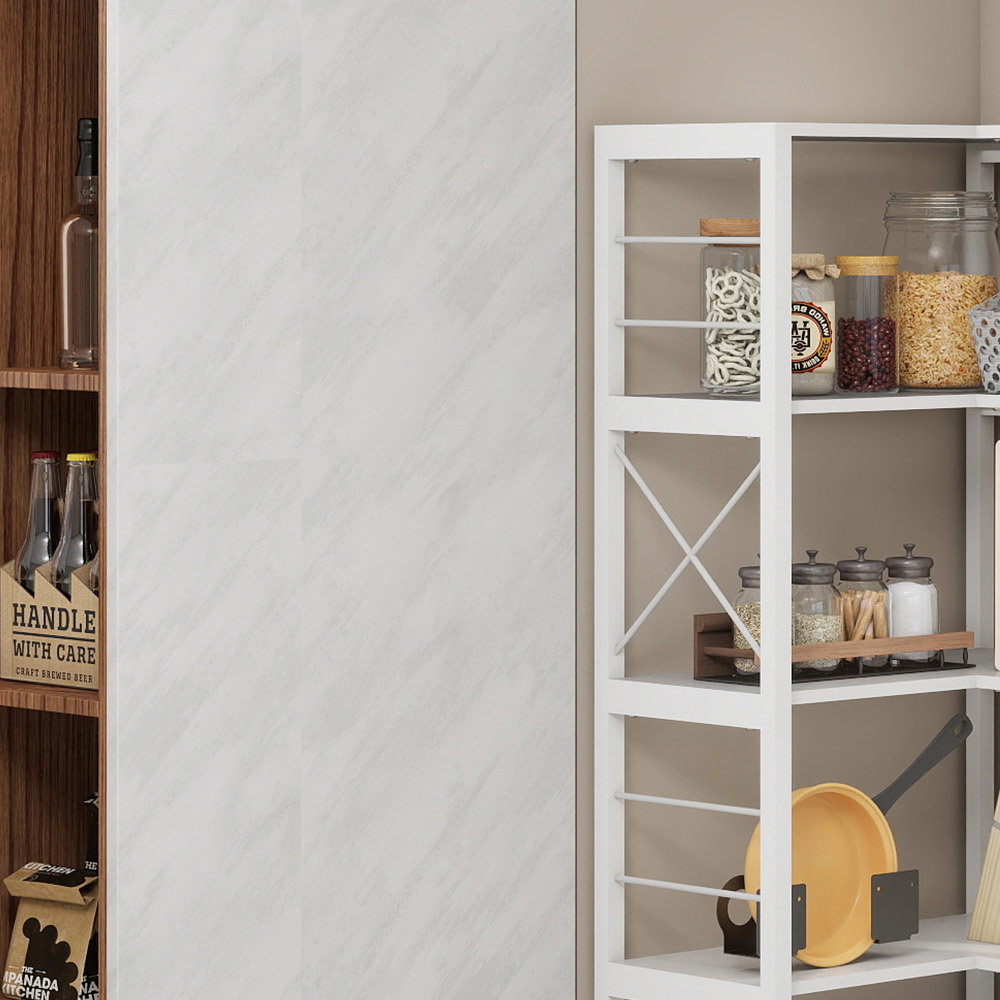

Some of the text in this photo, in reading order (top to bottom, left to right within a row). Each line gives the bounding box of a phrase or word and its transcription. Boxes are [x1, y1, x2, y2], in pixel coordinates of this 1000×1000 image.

[12, 603, 96, 634] HANDLE
[12, 639, 96, 665] WITH CARE
[15, 666, 93, 683] CRAFT BREWED BEER
[21, 965, 34, 974] THE
